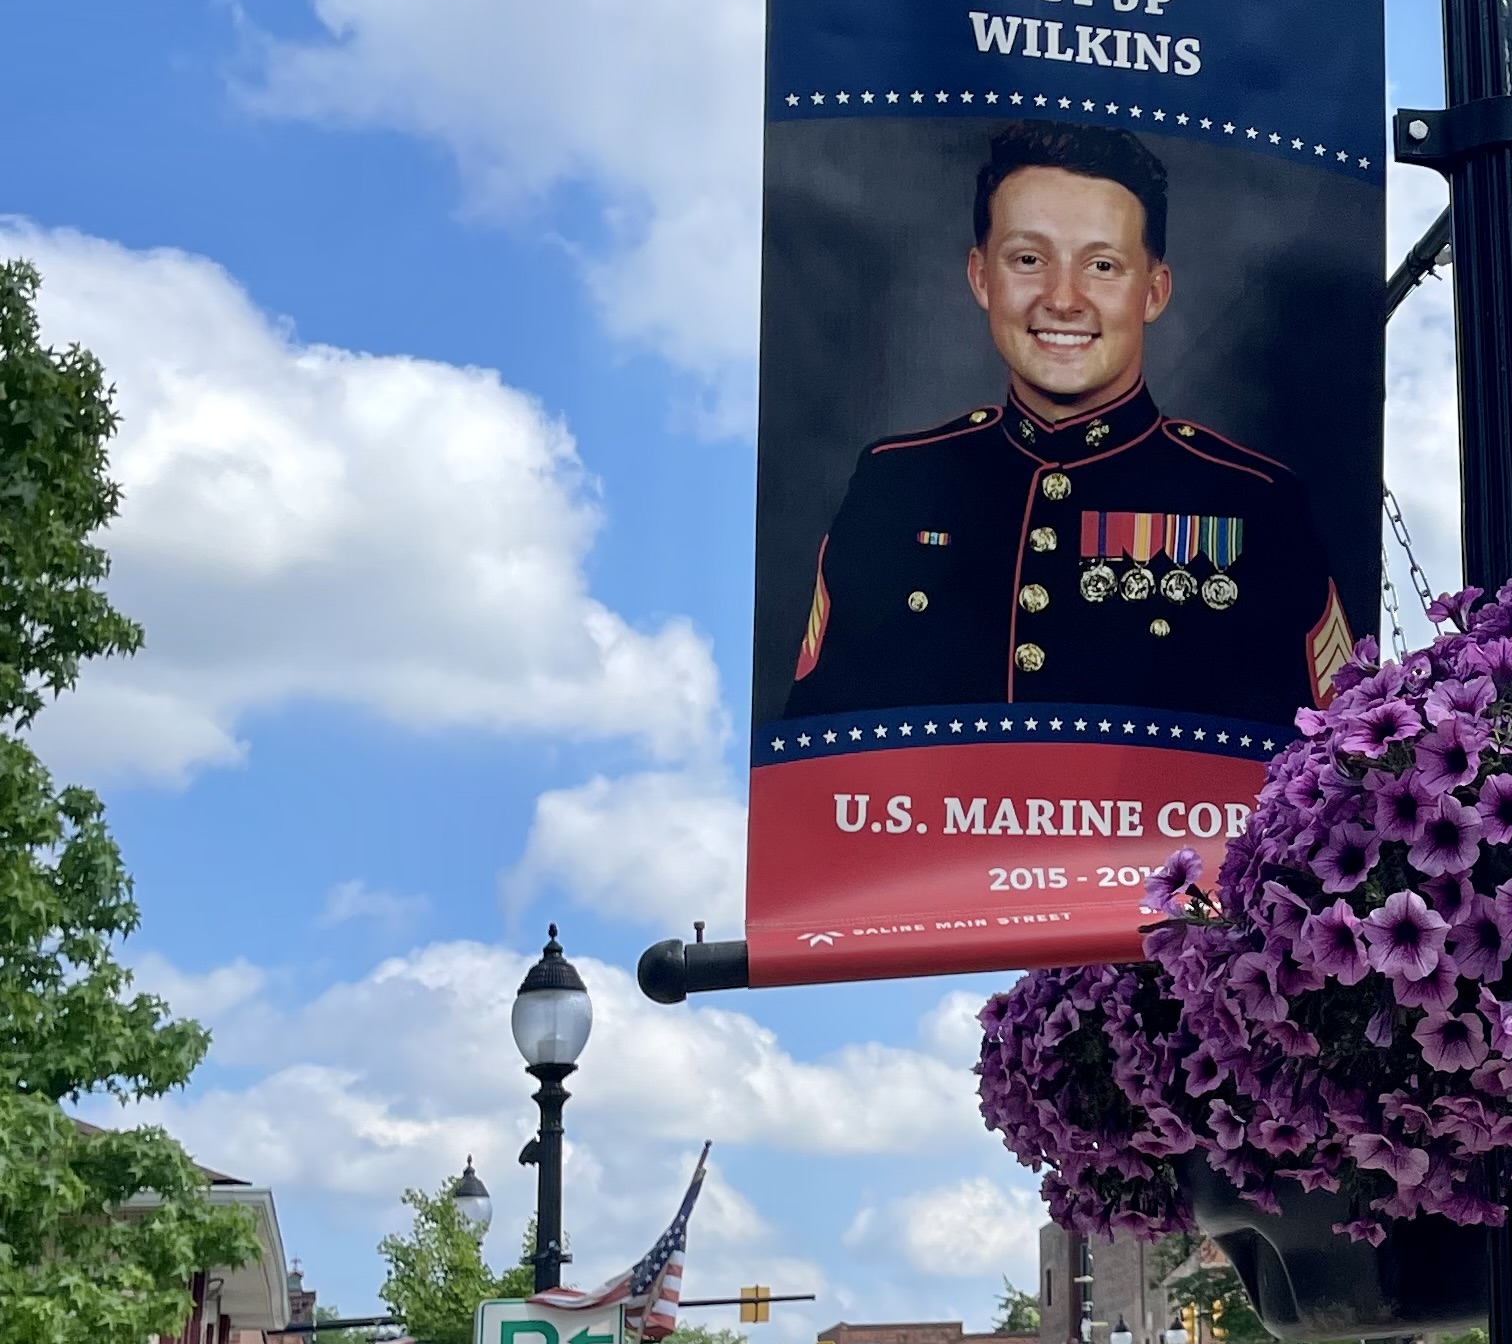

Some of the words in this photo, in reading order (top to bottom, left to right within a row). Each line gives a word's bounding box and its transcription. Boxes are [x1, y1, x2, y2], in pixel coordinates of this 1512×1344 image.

[968, 11, 1201, 76] WILKINS
[833, 794, 928, 834] U.S.
[943, 797, 1144, 838] MARINE
[1157, 801, 1261, 838] COR
[988, 867, 1068, 891] 2015
[852, 923, 926, 936] SALINE
[935, 918, 988, 930] MAIN
[996, 912, 1072, 926] STREET
